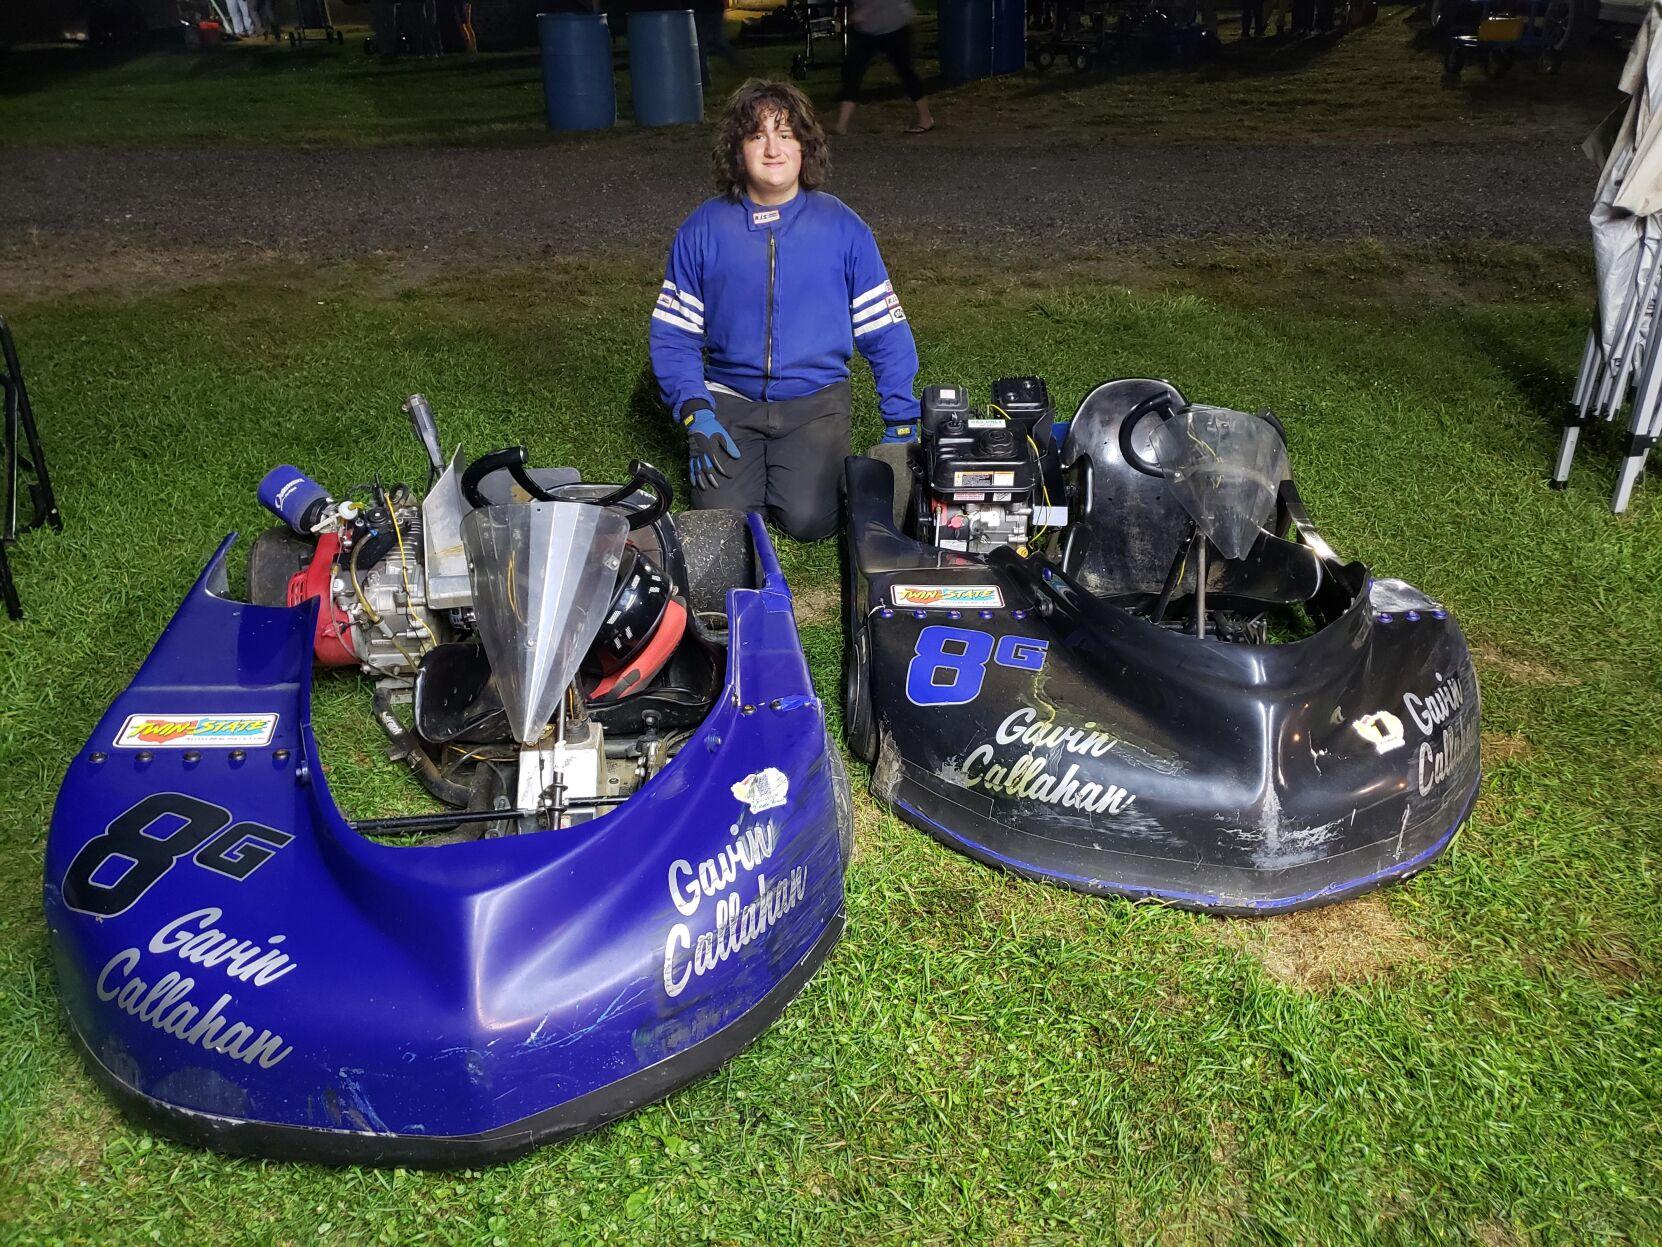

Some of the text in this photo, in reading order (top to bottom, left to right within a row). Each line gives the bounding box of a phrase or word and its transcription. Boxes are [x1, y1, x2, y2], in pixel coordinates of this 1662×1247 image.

[995, 707, 1118, 758] Gavin
[1403, 672, 1464, 736] Gavin
[961, 744, 1137, 815] Callahan
[668, 823, 773, 917] Gavin
[148, 907, 298, 987] Gavin
[663, 864, 808, 998] Callahan
[96, 947, 293, 1069] Callahan
